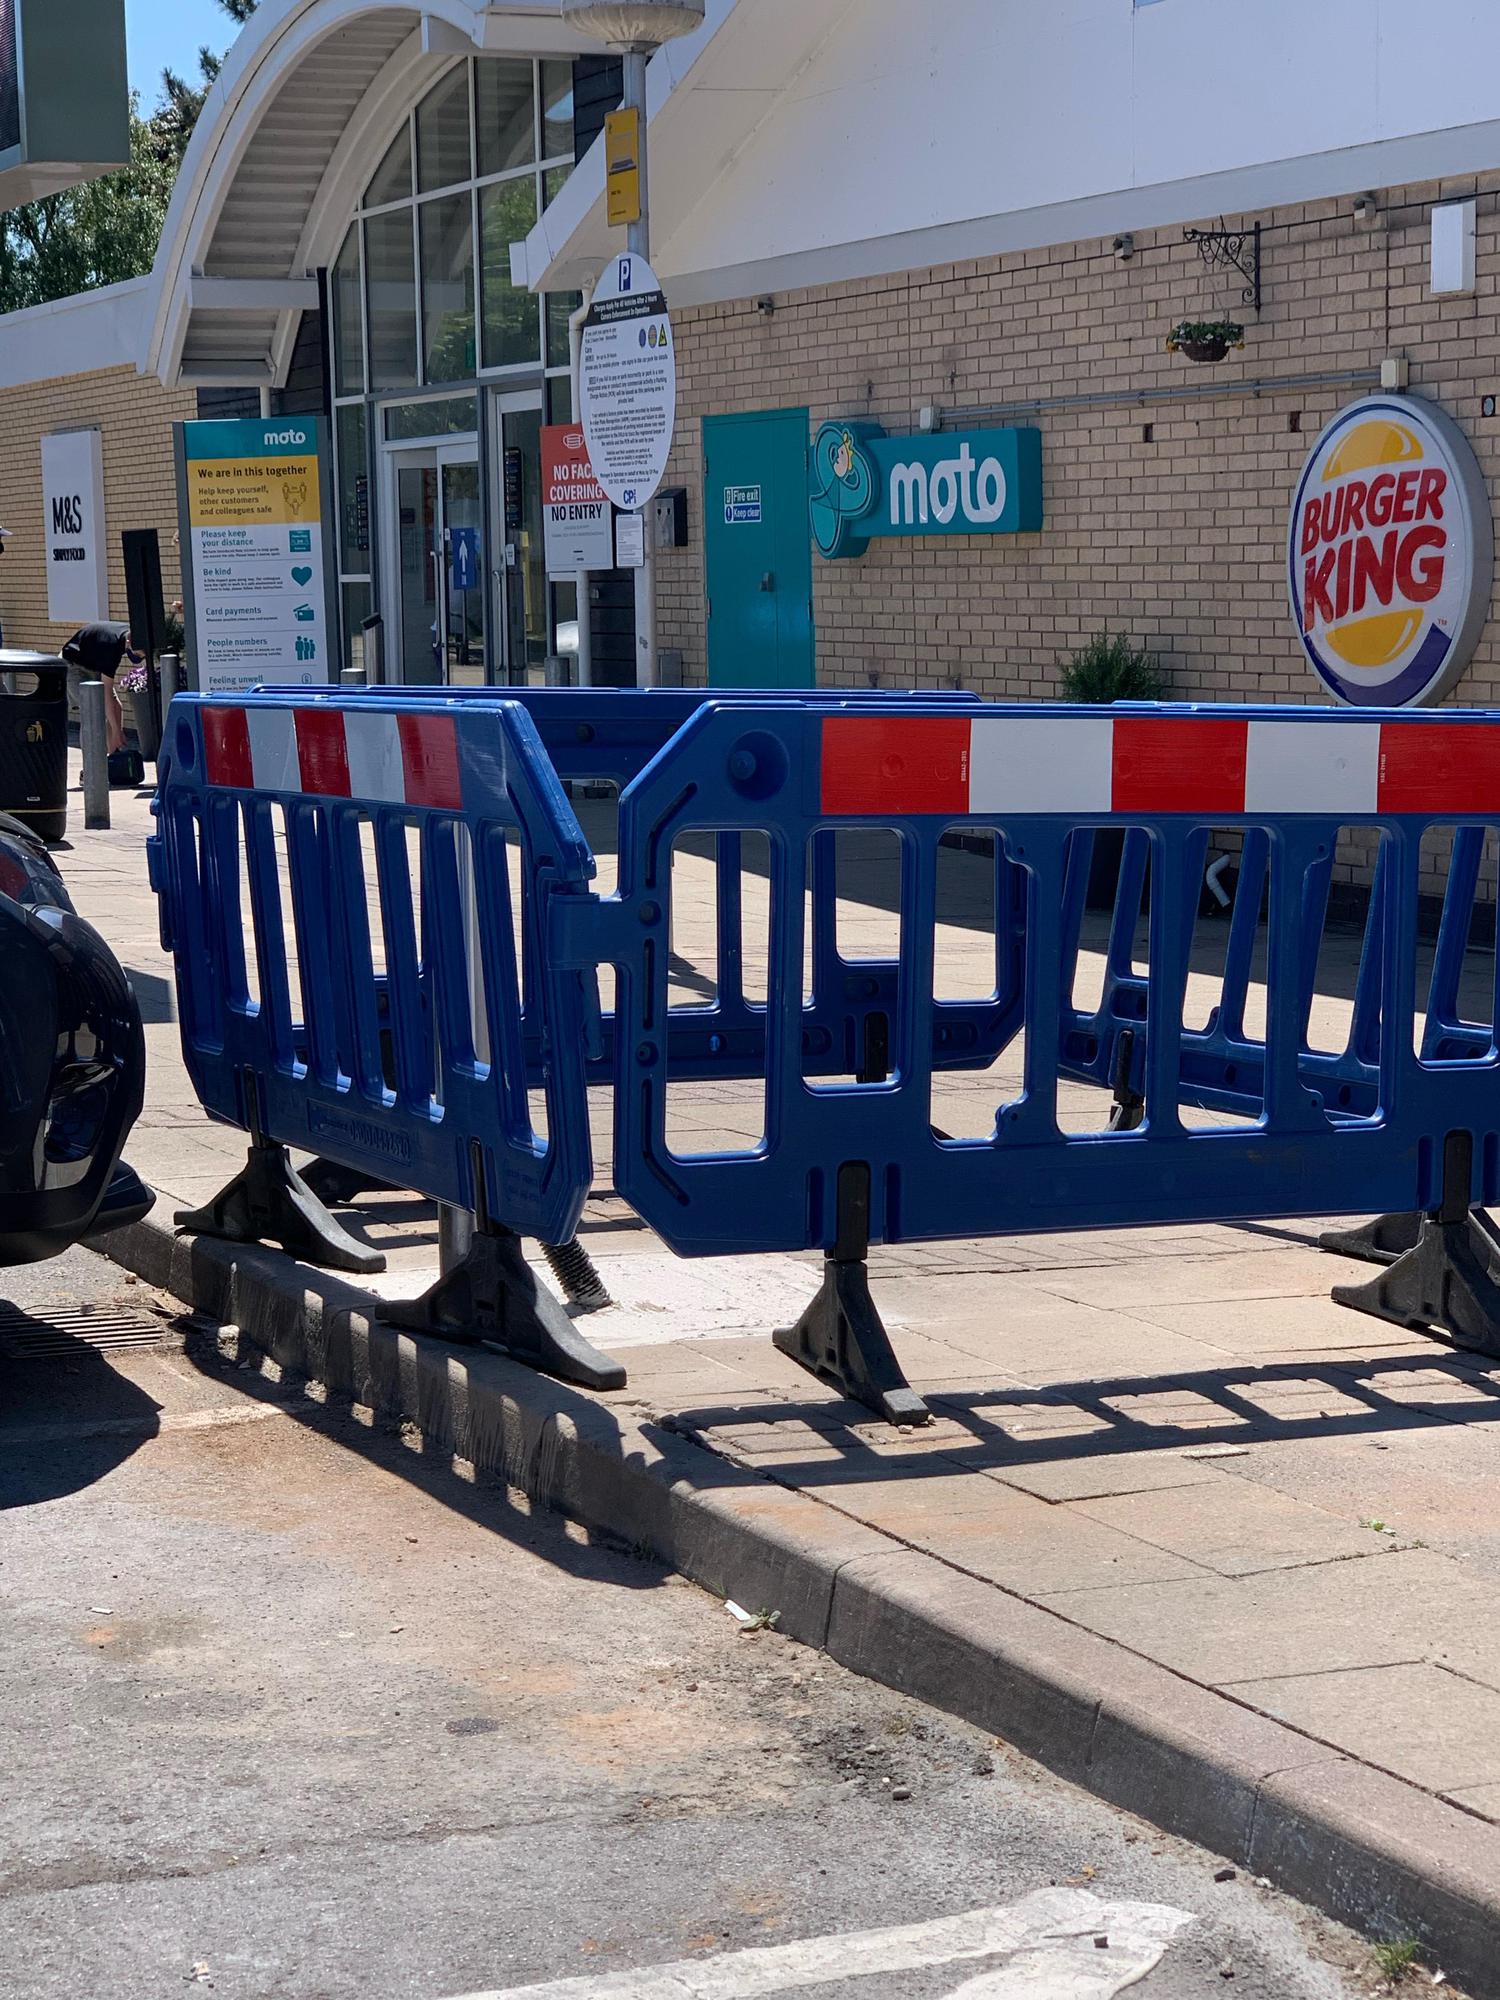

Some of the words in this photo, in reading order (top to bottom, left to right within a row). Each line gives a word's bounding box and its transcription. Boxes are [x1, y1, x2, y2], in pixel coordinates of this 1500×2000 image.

[621, 260, 630, 290] P
[264, 429, 306, 445] moto
[198, 469, 213, 478] We
[216, 470, 230, 478] are
[233, 467, 242, 477] in
[245, 466, 263, 476] this
[266, 465, 307, 477] together
[553, 464, 569, 480] NO
[571, 463, 597, 480] FAC
[889, 442, 1007, 524] moto
[198, 487, 215, 496] Help
[217, 486, 235, 495] keep
[236, 485, 269, 494] yourself,
[550, 484, 603, 502] COVERING
[734, 490, 746, 502] Fire
[746, 489, 758, 501] exit
[200, 497, 218, 505] other
[221, 496, 259, 504] customers
[52, 495, 82, 534] M&S
[215, 506, 254, 516] colleagues
[257, 505, 272, 514] safe
[552, 506, 566, 521] NO
[569, 504, 602, 520] ENTRY
[734, 508, 746, 519] Keep
[748, 507, 760, 517] clear
[1301, 468, 1448, 556] BURGER
[201, 530, 226, 539] Please
[228, 530, 246, 538] keep
[202, 539, 218, 547] your
[221, 538, 254, 546] distance
[203, 568, 213, 576] Be
[214, 568, 232, 576] kind
[1303, 524, 1448, 634] KING
[206, 607, 223, 616] Card
[224, 606, 262, 616] payments
[207, 638, 233, 648] People
[235, 638, 268, 646] numbers
[209, 676, 236, 685] Feeling
[238, 674, 264, 683] unwell
